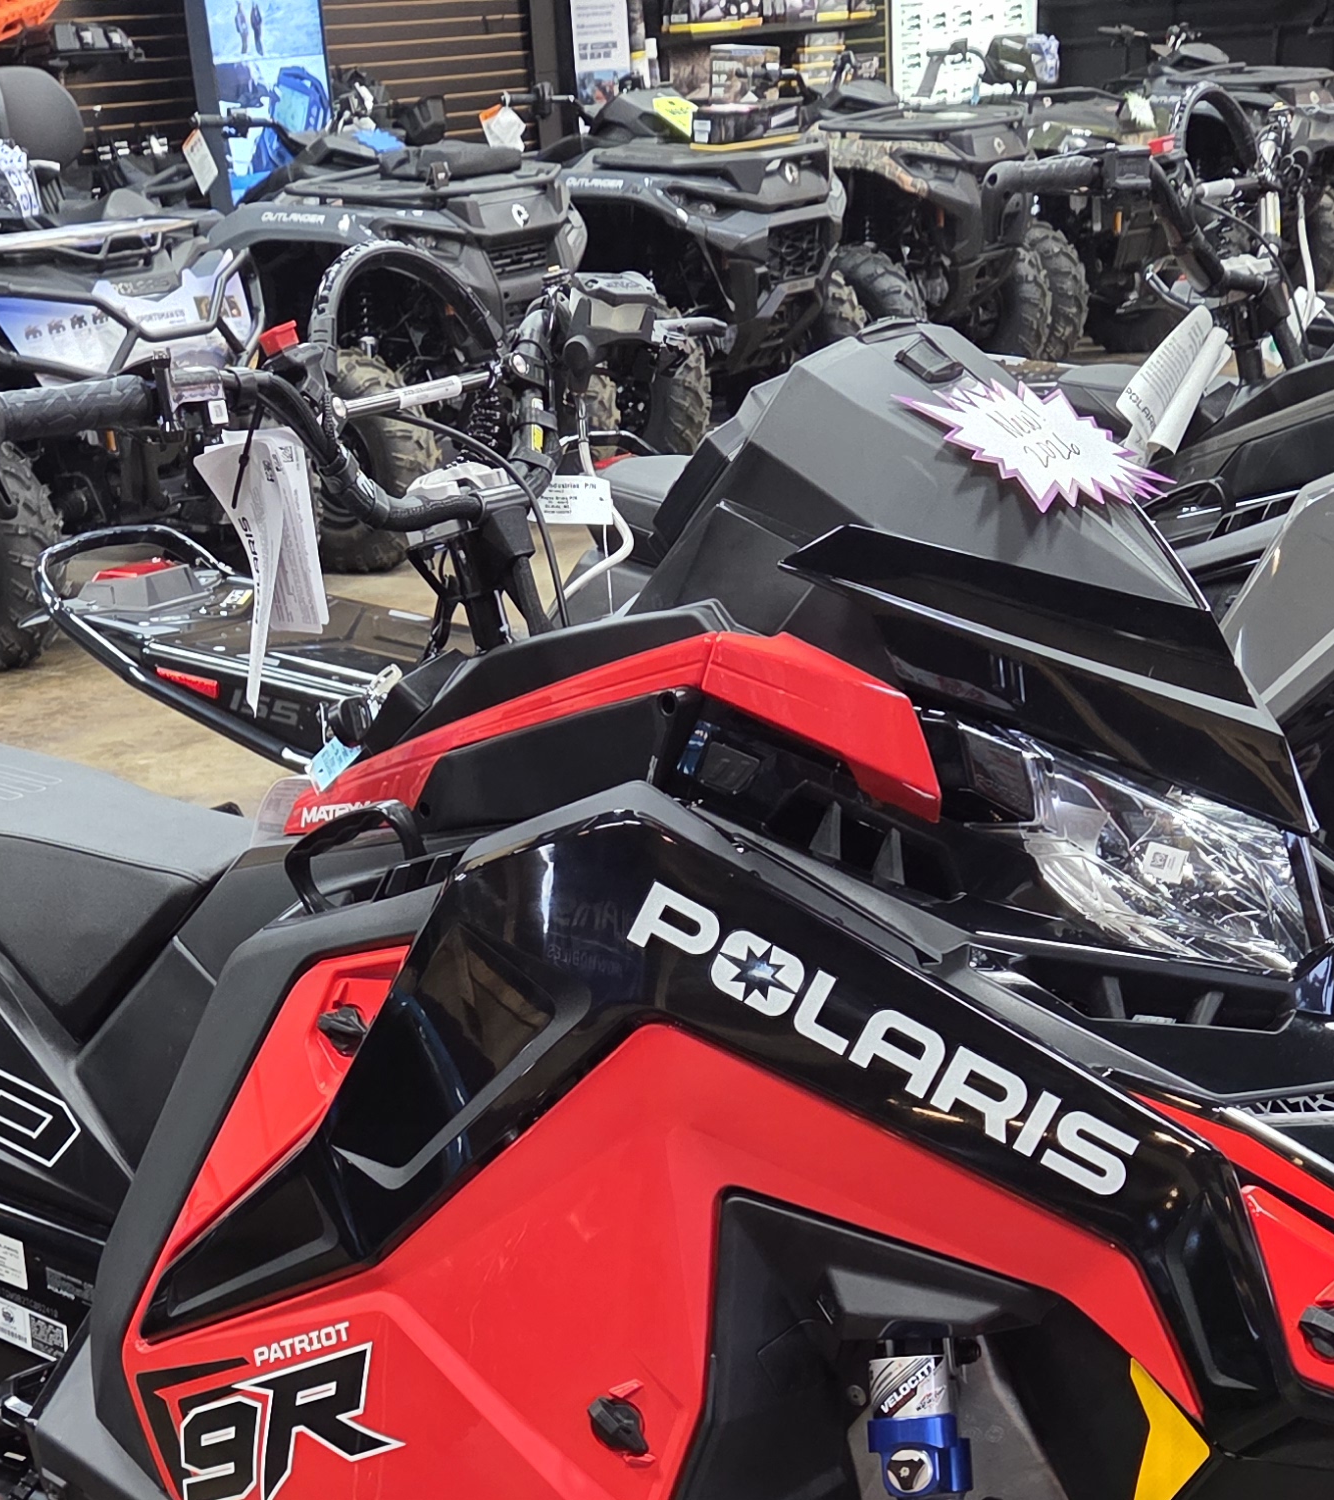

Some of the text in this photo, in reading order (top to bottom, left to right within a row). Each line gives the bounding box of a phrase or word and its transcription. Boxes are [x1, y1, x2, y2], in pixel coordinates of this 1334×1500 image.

[565, 176, 624, 190] OUTLANDER
[261, 211, 326, 226] OUTLANDER
[1023, 431, 1081, 469] 2026
[627, 881, 1140, 1197] POLARIS
[253, 1321, 351, 1369] PATRIOT
[880, 1356, 936, 1414] VELOCITY
